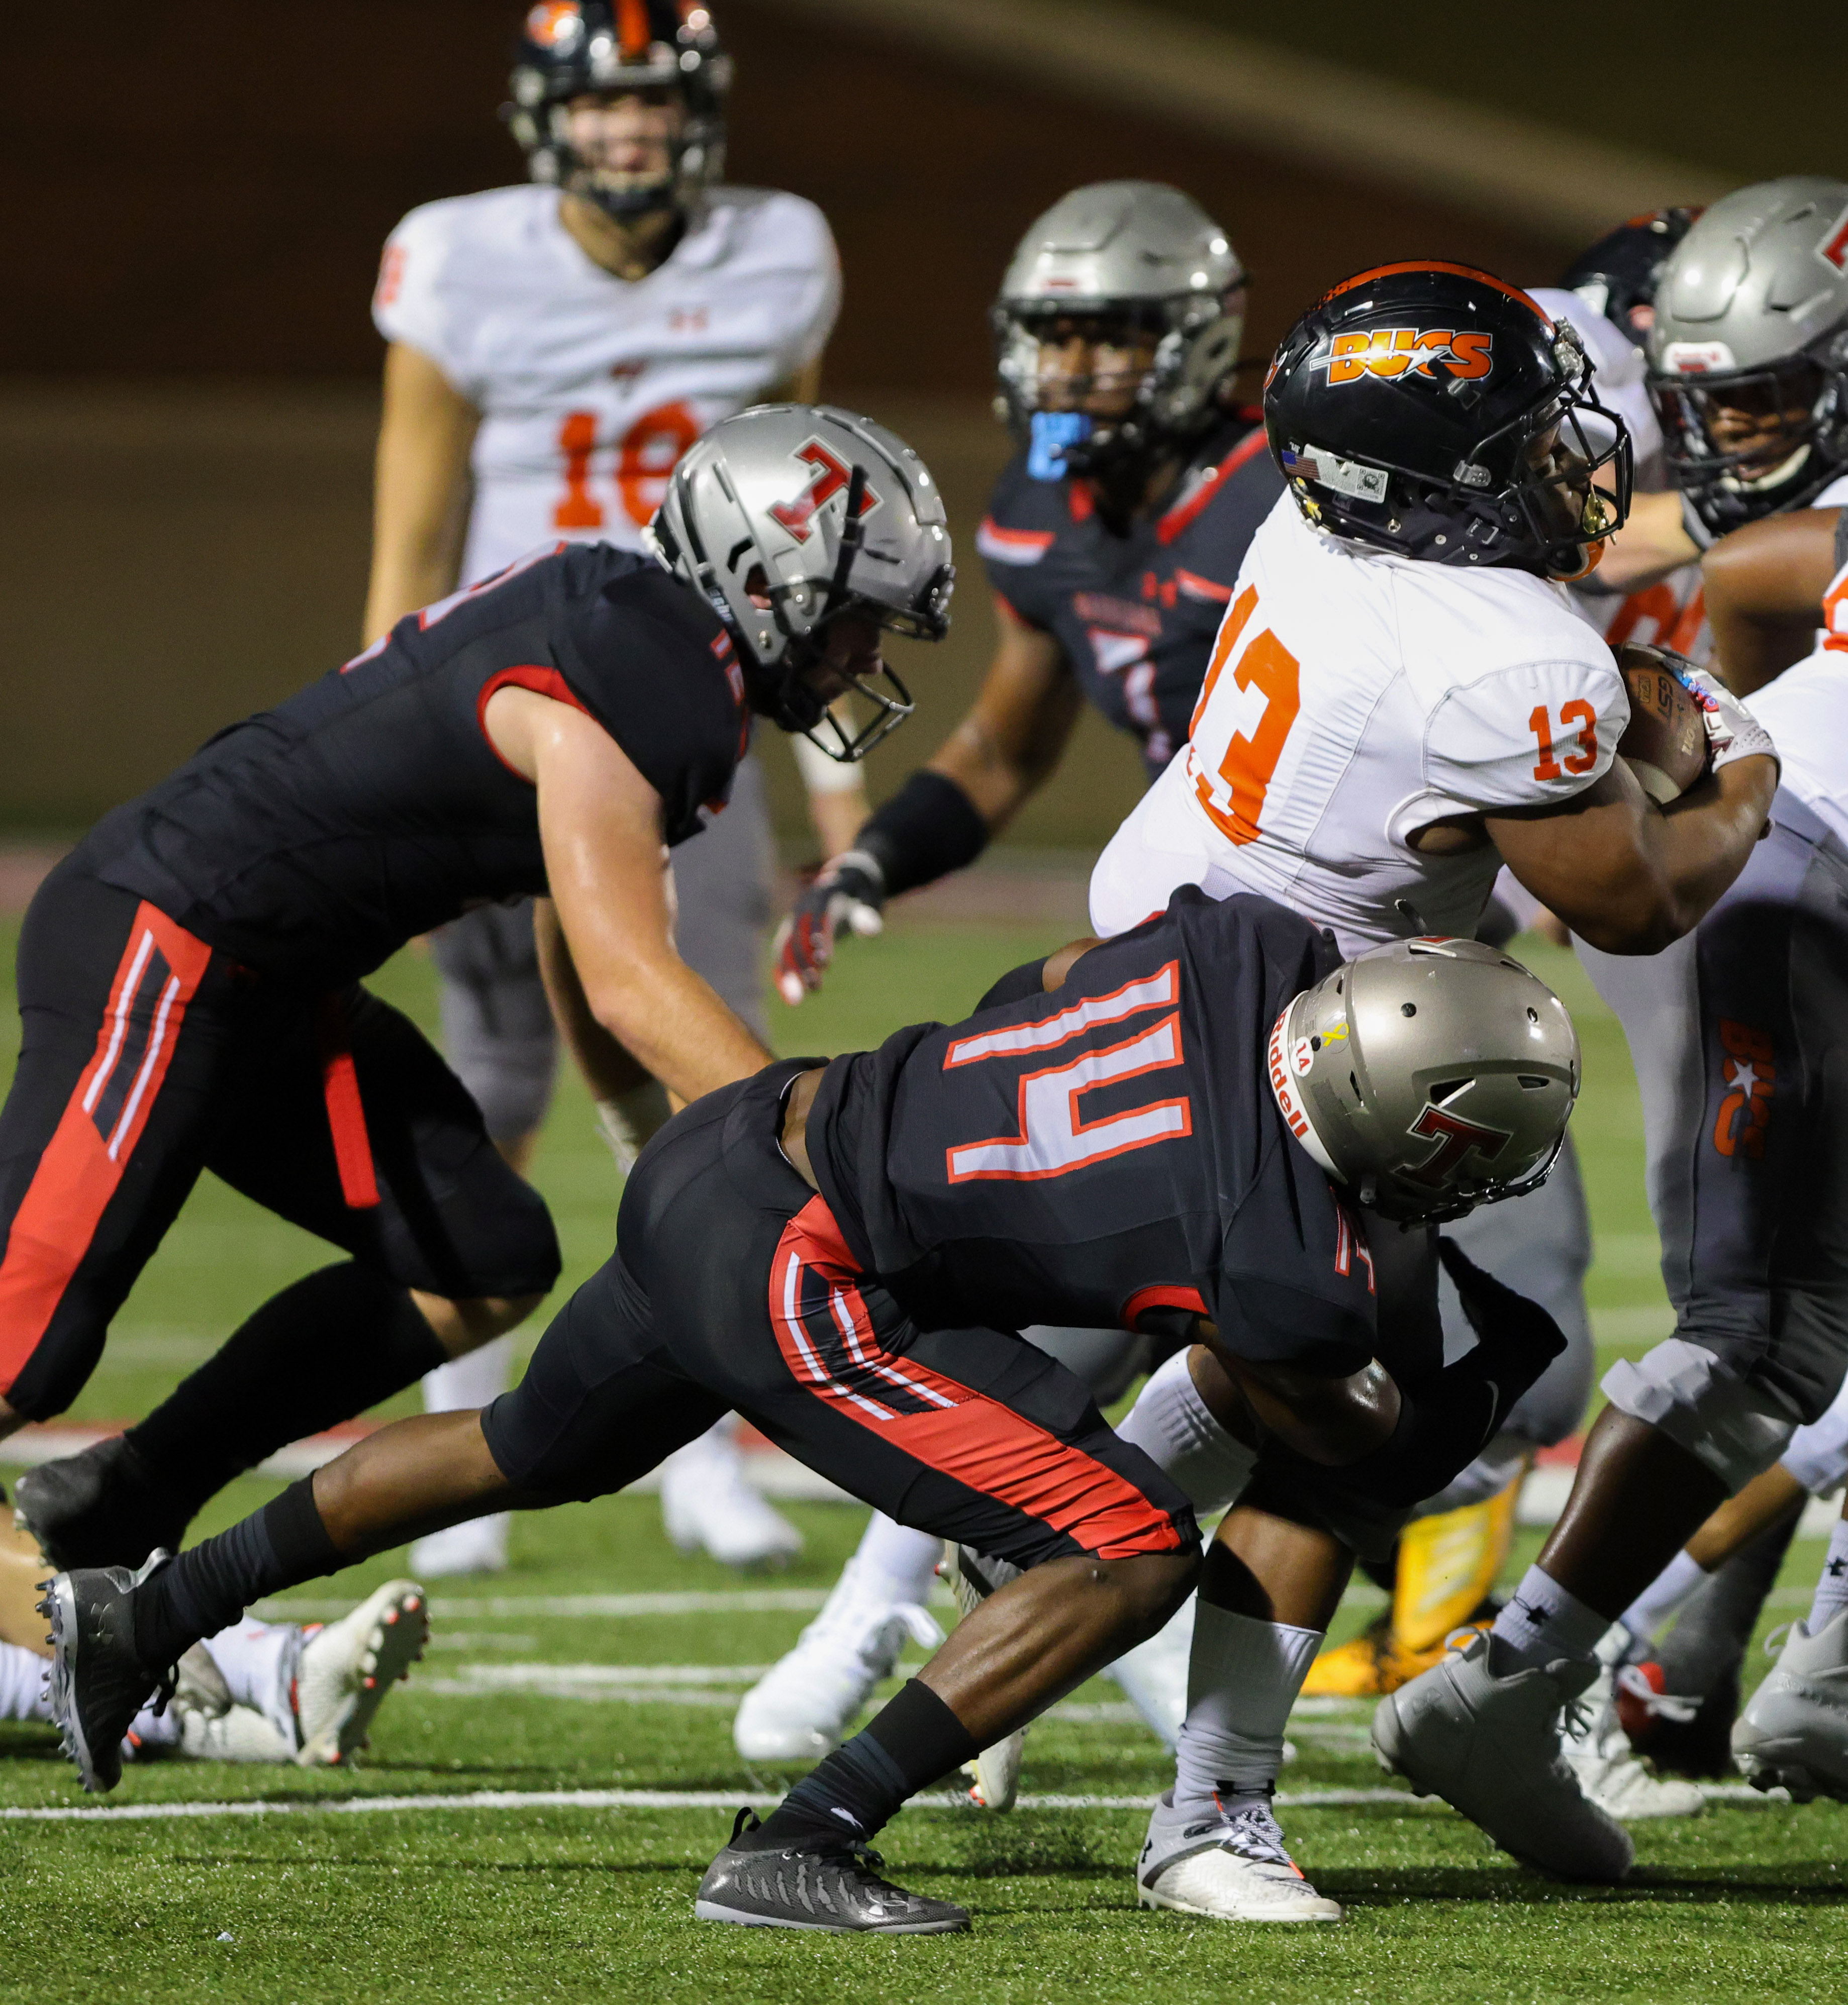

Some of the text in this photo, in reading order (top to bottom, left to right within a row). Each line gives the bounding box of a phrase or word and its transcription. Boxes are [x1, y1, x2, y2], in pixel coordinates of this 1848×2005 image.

[1326, 327, 1493, 387] BUCS
[1187, 582, 1301, 846] 13
[1529, 698, 1597, 781] 13
[943, 959, 1192, 1184] 14
[1269, 1010, 1309, 1139] Riddell
[1296, 1042, 1310, 1071] 14
[1391, 1101, 1514, 1190] T
